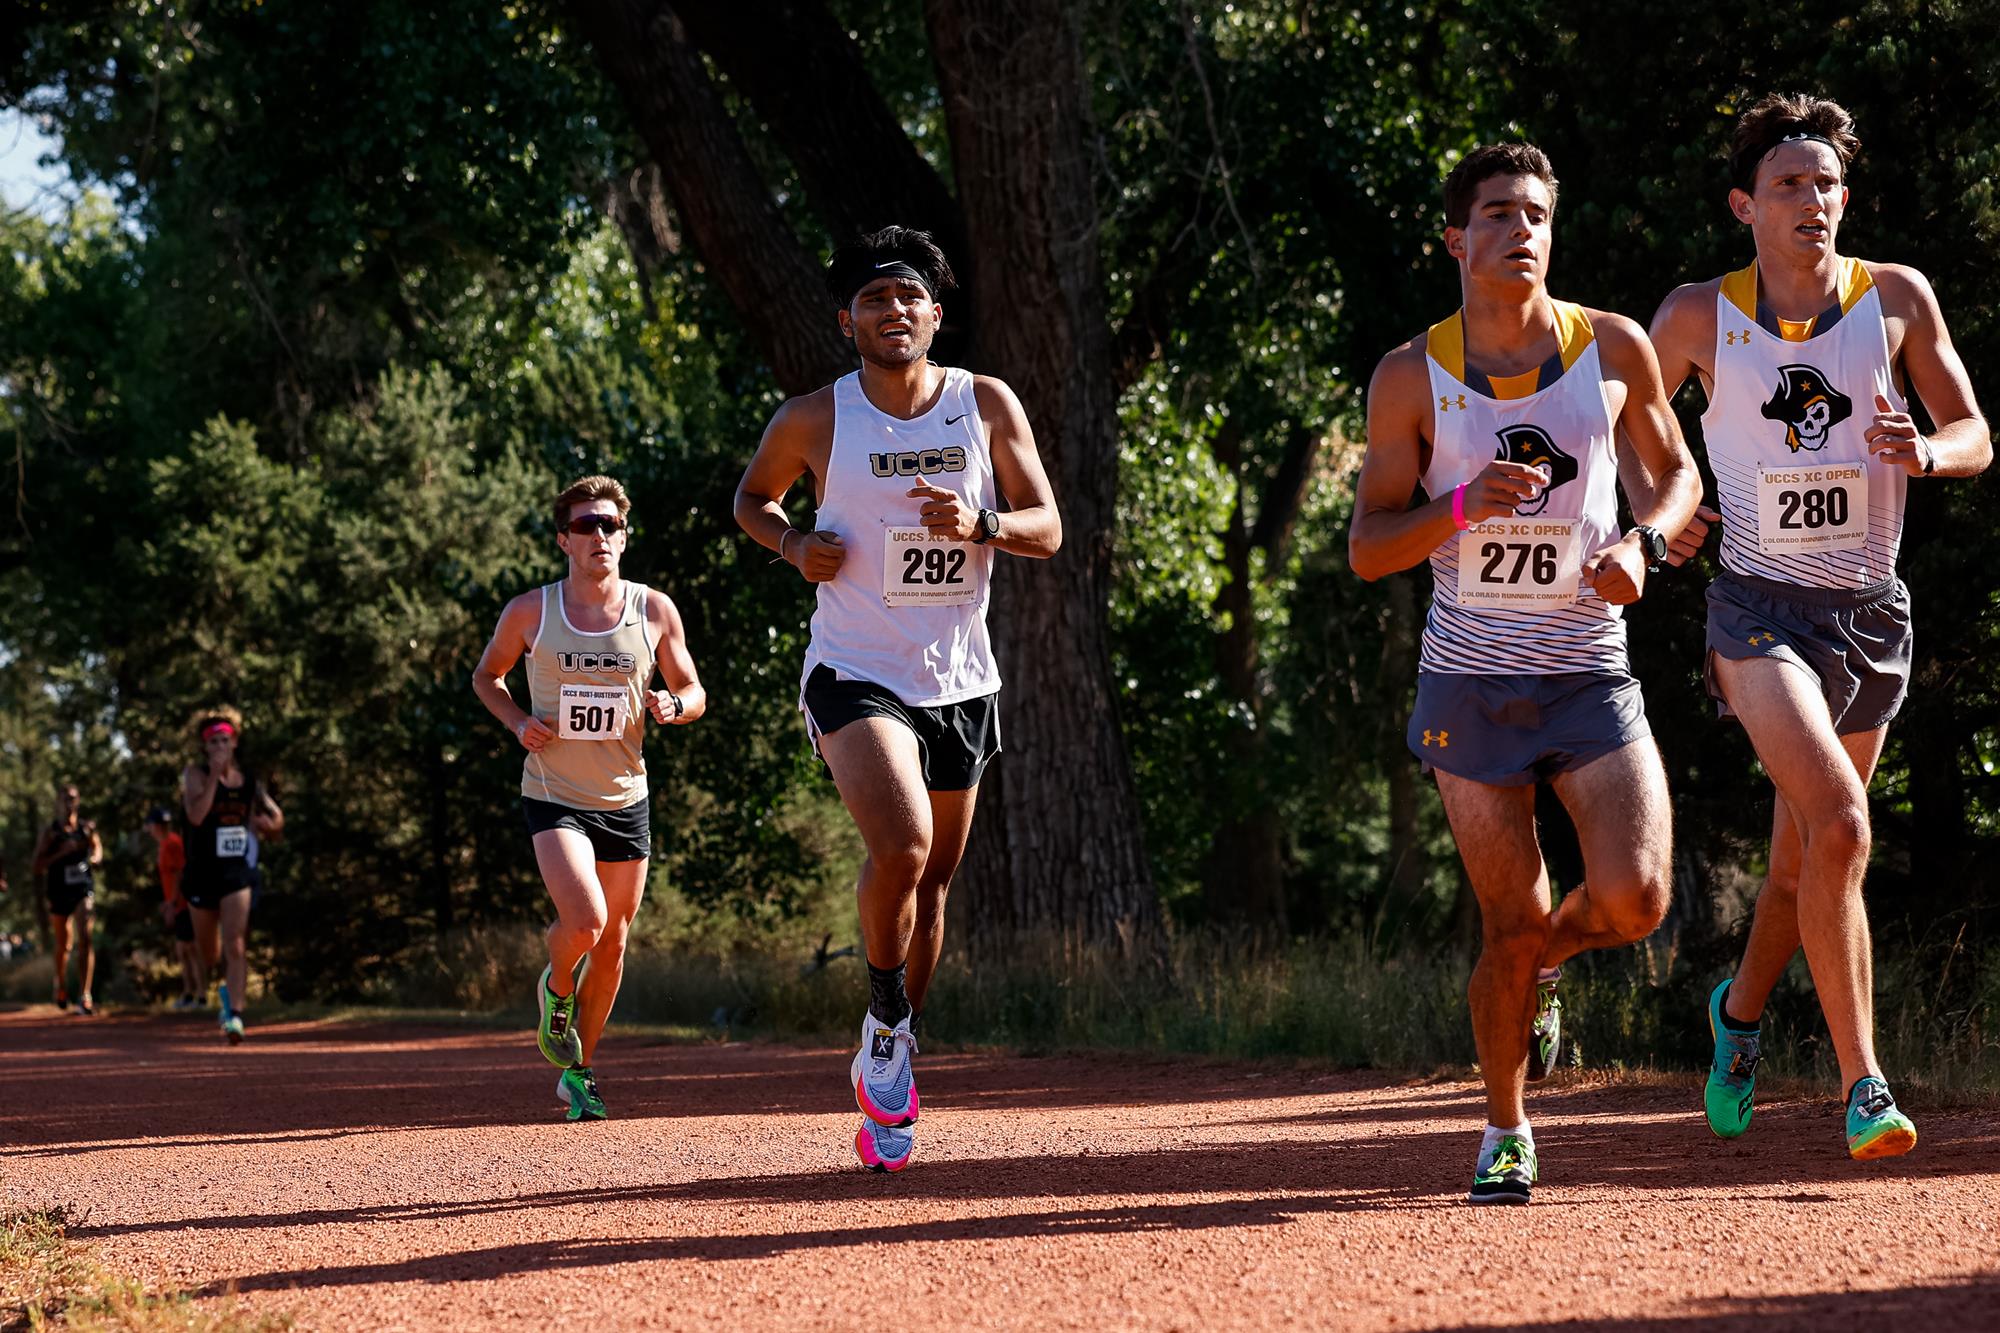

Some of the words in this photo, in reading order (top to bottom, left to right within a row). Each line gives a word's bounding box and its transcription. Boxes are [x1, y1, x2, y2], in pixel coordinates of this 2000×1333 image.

[869, 446, 967, 478] UCCS
[1764, 473, 1800, 484] UCCS
[1804, 472, 1822, 482] XC
[1825, 469, 1860, 480] OPEN
[1778, 486, 1848, 529] 280
[892, 532, 924, 542] UCCS
[1510, 524, 1529, 535] XC
[1533, 525, 1571, 536] OPEN
[1800, 535, 1831, 543] RUNNING
[1832, 532, 1865, 540] COMPANY
[902, 548, 966, 585] 292
[1480, 542, 1557, 585] 276
[1461, 591, 1500, 599] COLORADO
[557, 652, 636, 674] UCCS
[570, 705, 615, 733] 501
